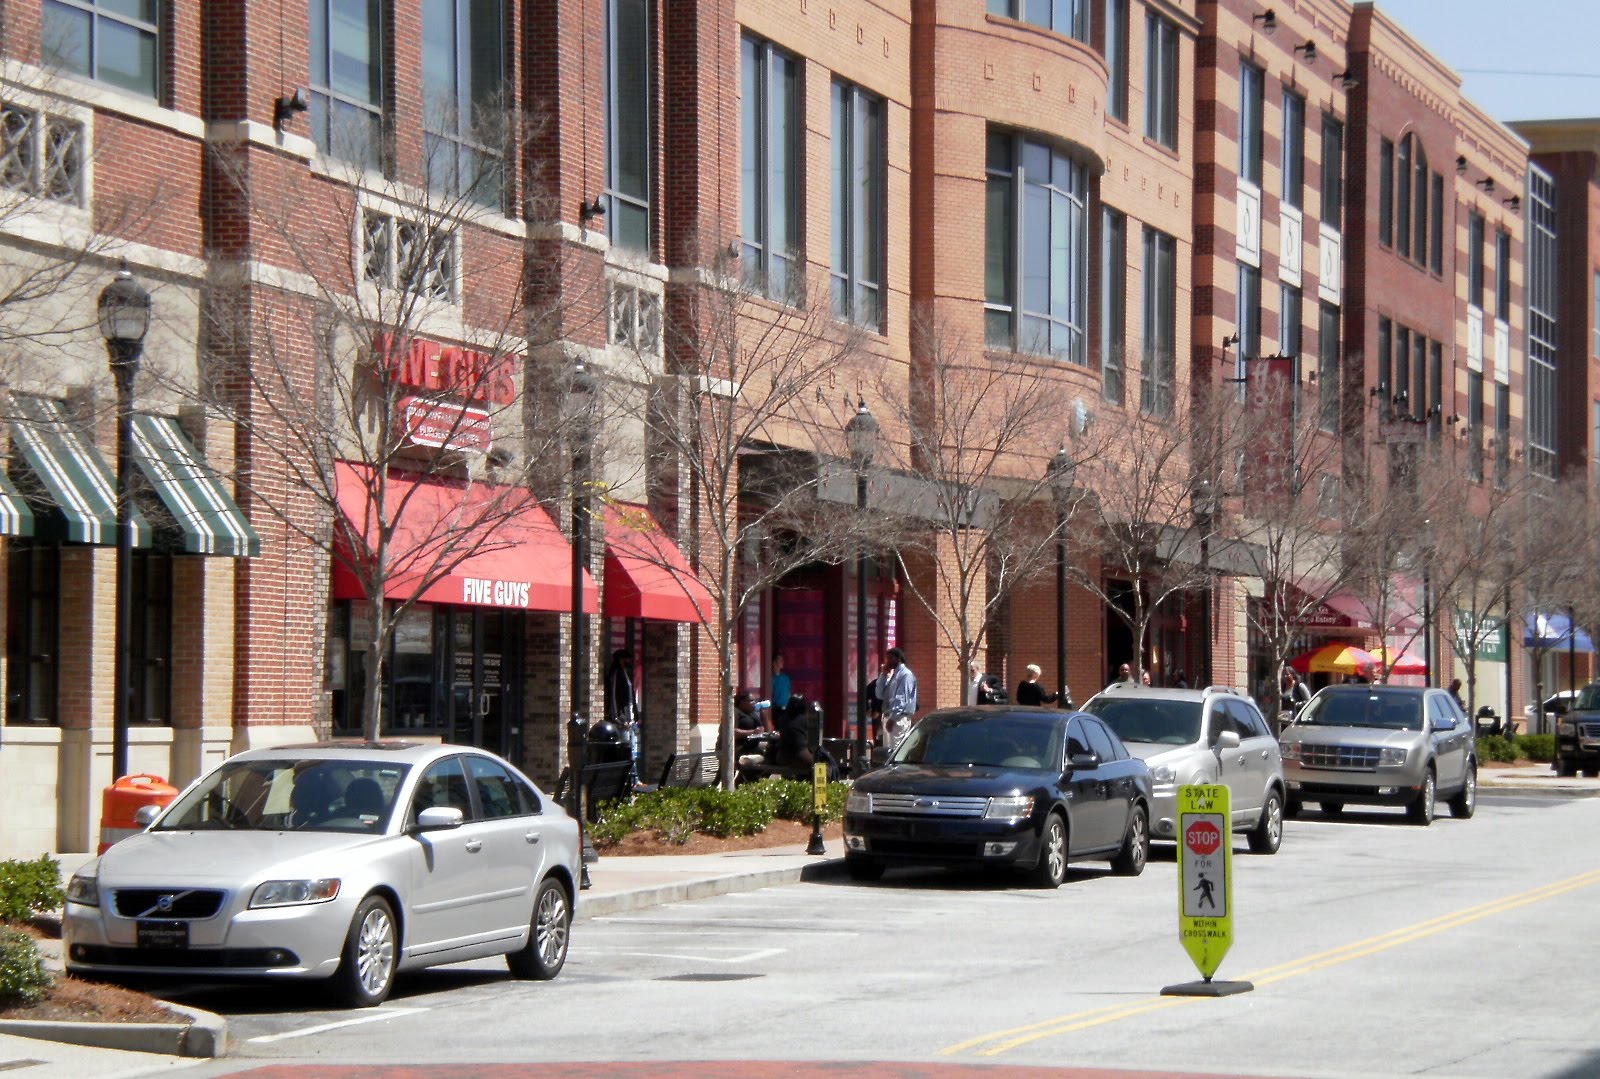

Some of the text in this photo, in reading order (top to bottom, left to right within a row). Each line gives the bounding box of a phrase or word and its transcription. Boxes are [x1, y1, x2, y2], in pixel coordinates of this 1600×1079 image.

[463, 577, 529, 608] FIVE GUYS
[1185, 788, 1219, 798] STATE
[1190, 800, 1214, 810] LAW
[1188, 831, 1218, 845] STOP
[1194, 860, 1212, 868] FOR
[1193, 919, 1217, 928] WITHIN
[1183, 930, 1226, 938] CROSSWALK
